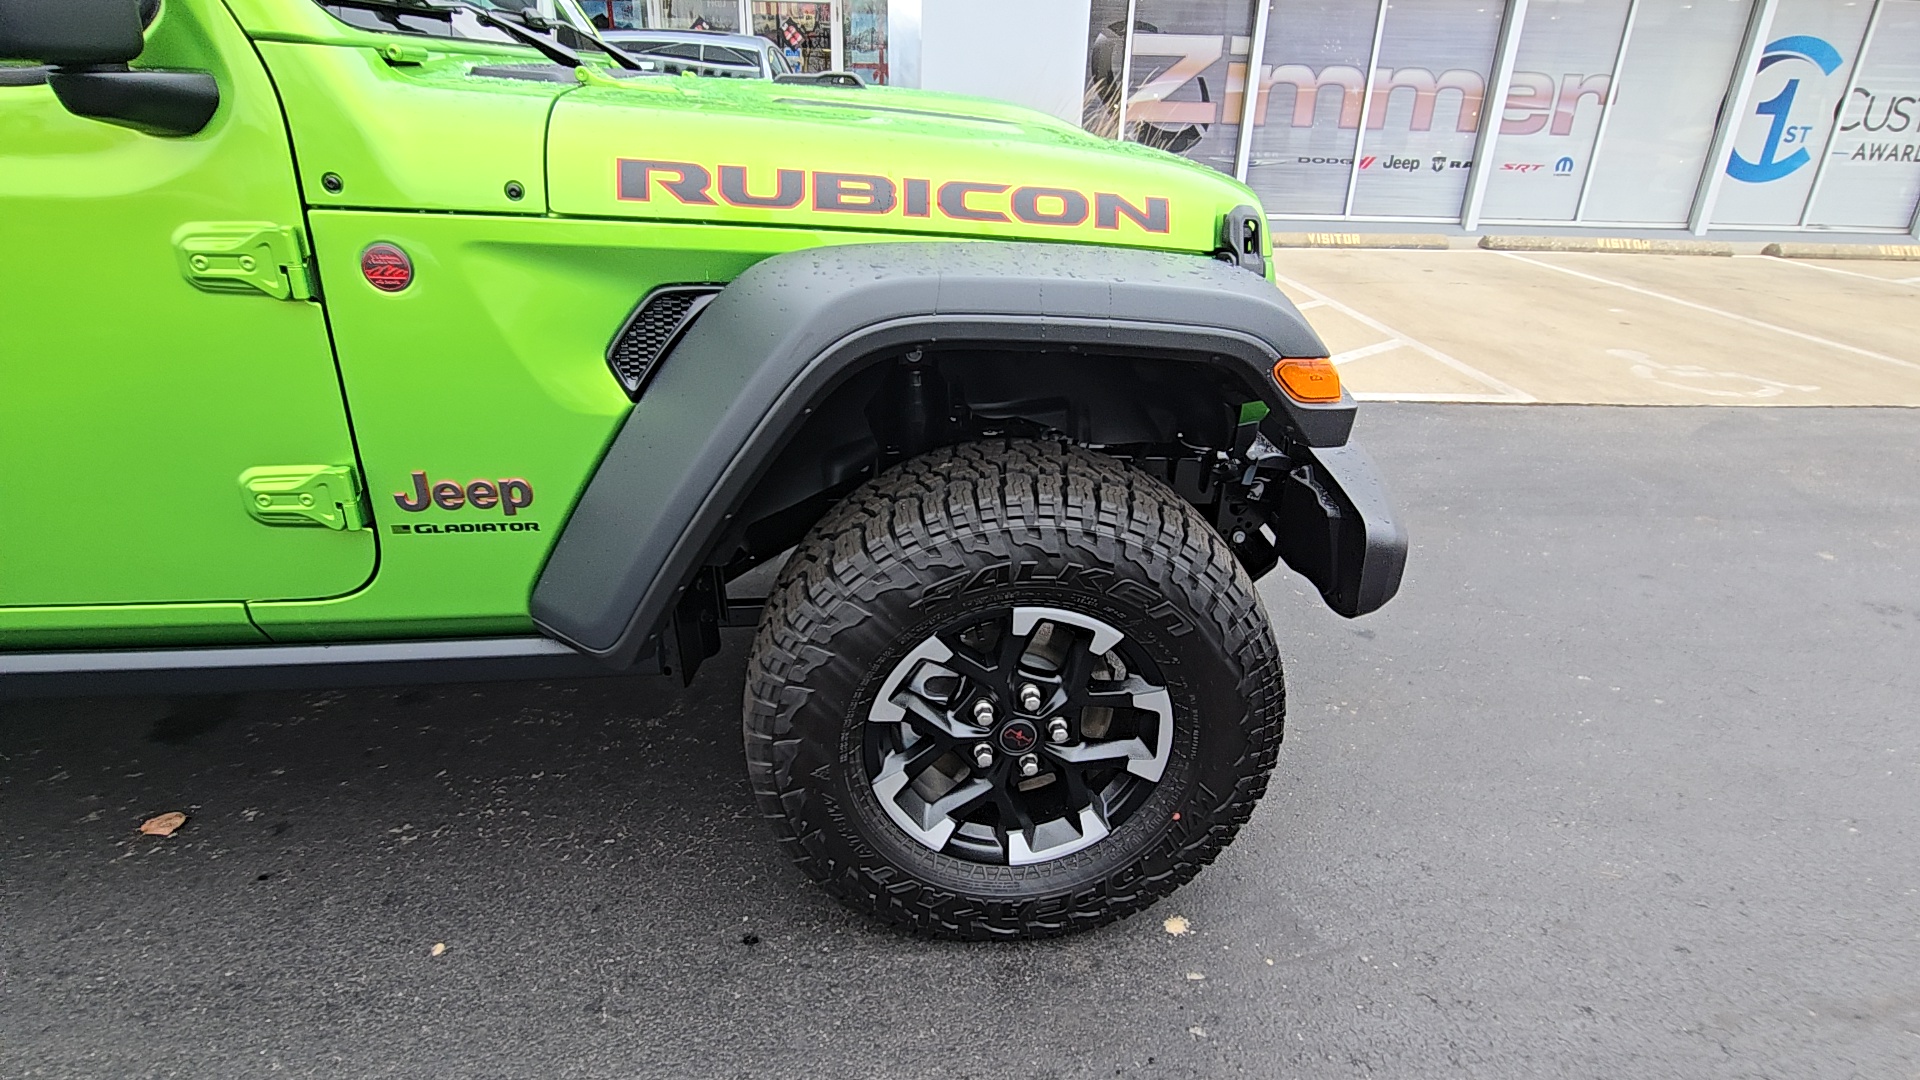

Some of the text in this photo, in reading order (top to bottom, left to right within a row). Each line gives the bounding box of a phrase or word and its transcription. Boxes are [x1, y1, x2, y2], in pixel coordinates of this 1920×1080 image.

[1123, 33, 1618, 137] Zimmer
[1834, 87, 1920, 132] CUS
[1298, 157, 1353, 165] DODG
[1382, 155, 1420, 173] Jeep
[1449, 160, 1473, 169] RA
[1500, 163, 1545, 173] SRT
[616, 158, 1170, 234] RUBICON
[1307, 233, 1361, 244] VISITOR
[1596, 238, 1651, 250] VISITOR
[393, 470, 534, 516] Jeep
[414, 522, 540, 534] GLADIATOR
